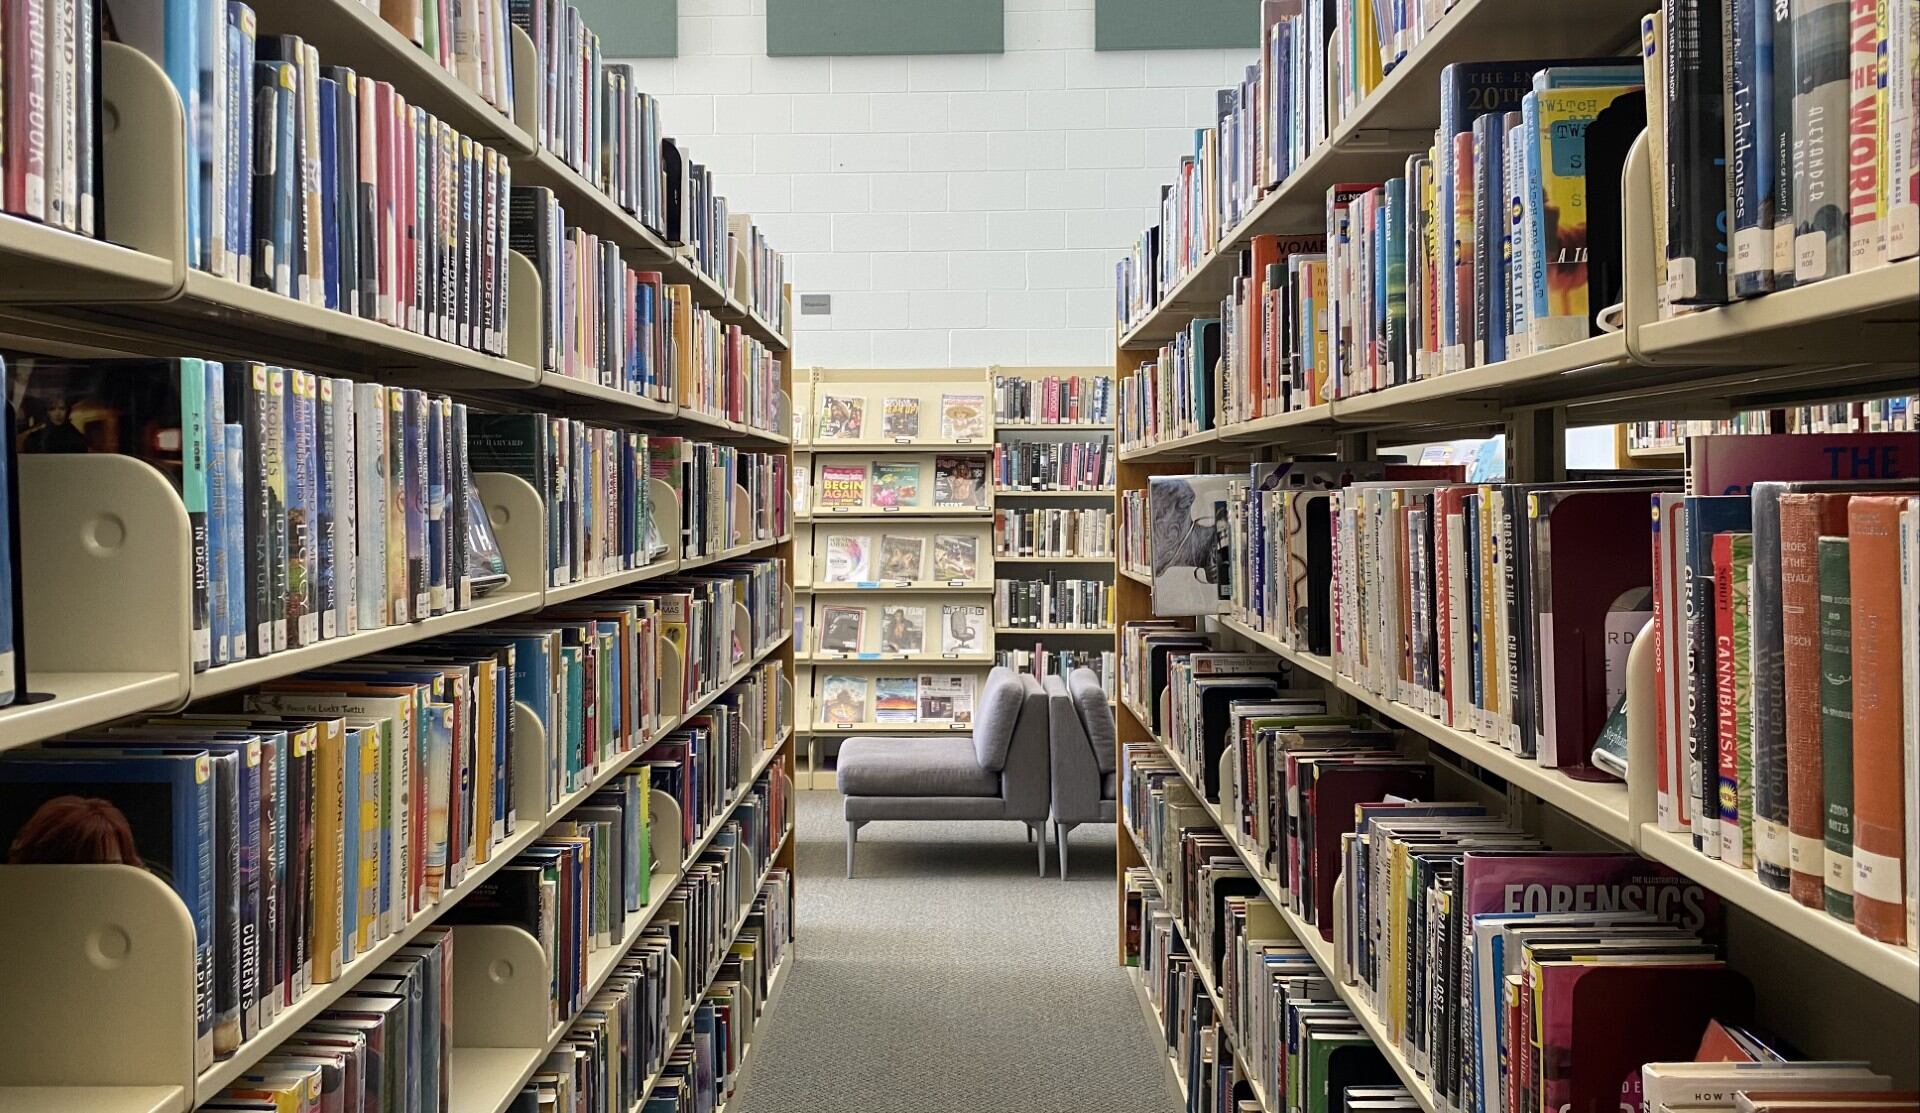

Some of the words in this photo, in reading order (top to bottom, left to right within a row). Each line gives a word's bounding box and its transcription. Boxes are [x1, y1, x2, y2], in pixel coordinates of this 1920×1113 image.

[1851, 64, 1877, 90] THE
[29, 91, 45, 166] BOOK
[1734, 85, 1751, 219] Lighthouses
[1793, 139, 1804, 180] ROSE
[1808, 106, 1825, 203] ALEXANDER
[1894, 132, 1902, 175] DEIRDRE
[1780, 178, 1788, 205] FLIGHT
[1894, 177, 1903, 205] MASK
[486, 203, 496, 257] ROBB
[1385, 197, 1393, 241] Nuclear
[1477, 200, 1485, 259] BENEATH
[1513, 227, 1523, 245] TO
[441, 267, 449, 304] DEATH
[1477, 265, 1485, 289] THE
[1513, 250, 1523, 280] RISK
[448, 269, 457, 316] DEATH
[484, 281, 493, 326] DEATH
[1477, 294, 1485, 336] WALLS
[1513, 285, 1523, 298] IT
[1514, 303, 1524, 326] ALL
[267, 400, 279, 477] ROBERTS
[346, 399, 355, 441] NORA
[485, 439, 524, 447] HARVARD
[346, 449, 355, 511] ROBERTS
[823, 479, 864, 489] BEGIN
[1823, 445, 1901, 480] THE
[823, 489, 864, 499] AGAIN
[194, 525, 204, 541] IN
[1254, 506, 1262, 541] Waiter
[1434, 496, 1443, 540] WHEN
[1503, 514, 1513, 560] GHOSTS
[275, 512, 287, 604] IDENTITY
[296, 524, 309, 610] LEGACY
[308, 519, 316, 575] GAMES
[325, 522, 335, 608] NIGHTWORK
[1481, 510, 1490, 577] DAUGHTERS
[194, 545, 204, 590] DEATH
[255, 534, 267, 606] NATURE
[1331, 536, 1340, 638] HYSTERICAL
[1417, 534, 1428, 621] DOPESICK
[1435, 542, 1445, 594] CRACK
[1504, 565, 1514, 579] OF
[1717, 566, 1728, 613] SCHUTT
[1436, 600, 1446, 632] WAS
[1505, 584, 1515, 606] THE
[1507, 634, 1519, 701] CHRISTINE
[1655, 631, 1663, 673] FOODS
[1684, 565, 1697, 729] GROUNDHOG
[1717, 635, 1736, 770] CANNIBALISM
[1769, 650, 1786, 735] Women
[267, 755, 276, 807] WHEN
[1770, 743, 1788, 796] Who
[335, 767, 344, 823] GOWN
[266, 847, 276, 882] WAS
[334, 827, 344, 894] JENNIFER
[266, 885, 277, 932] GOOD
[1504, 883, 1705, 934] FORENSICS
[242, 923, 255, 1010] CURRENTS
[1406, 916, 1414, 973] RADIUM
[195, 974, 205, 1024] PLACE
[1406, 978, 1414, 1020] GIRLS
[1436, 974, 1445, 1014] LOST
[1449, 1018, 1457, 1052] Nutshell
[1520, 1012, 1530, 1083] Everything
[1474, 1027, 1483, 1113] LISTENERS
